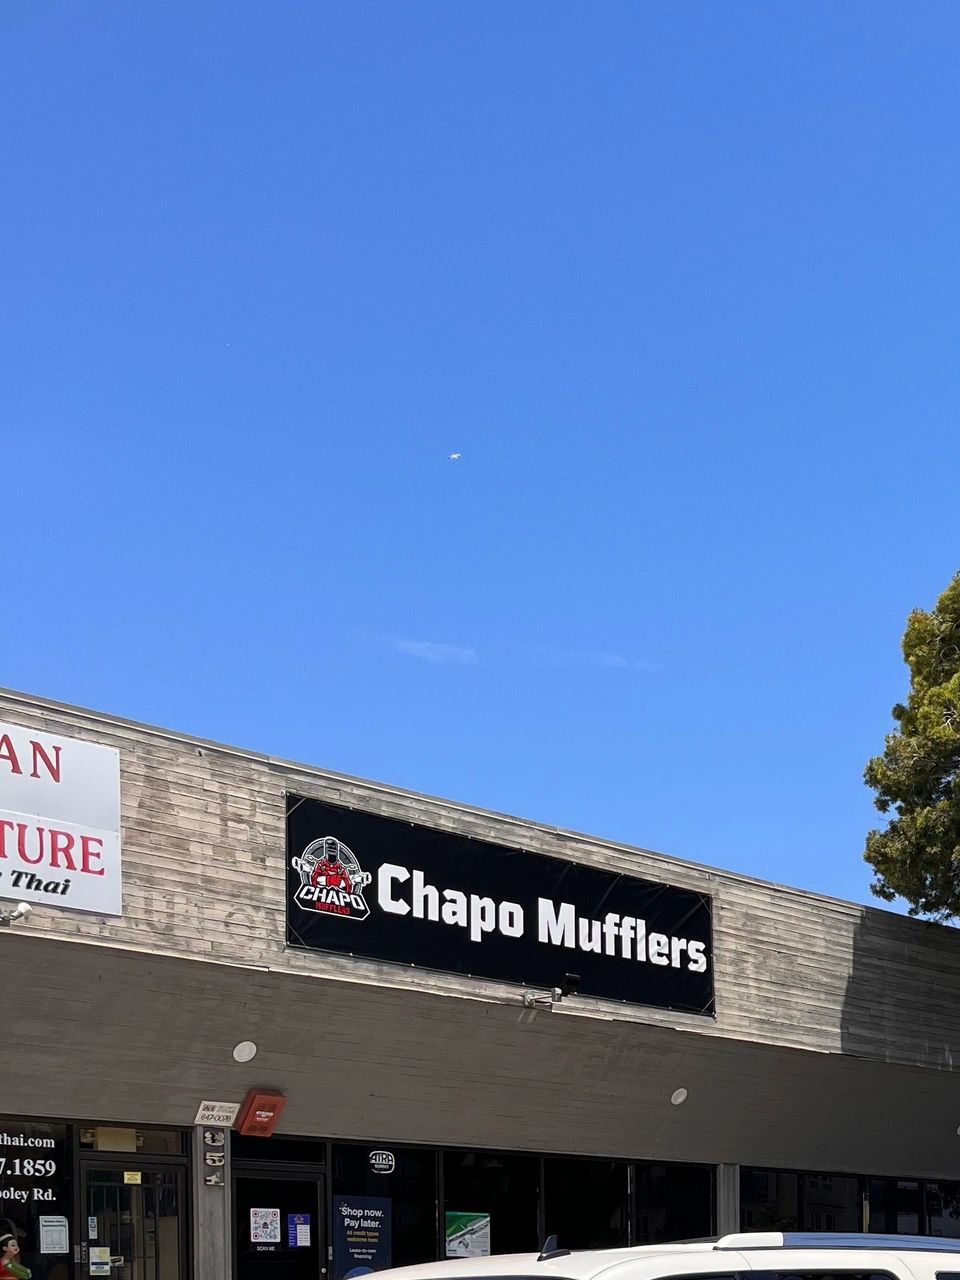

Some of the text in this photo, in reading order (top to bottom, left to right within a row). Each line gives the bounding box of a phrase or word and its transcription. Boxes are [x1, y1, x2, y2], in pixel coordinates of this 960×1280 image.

[10, 870, 71, 896] Thai
[300, 885, 366, 911] CHAPO
[315, 901, 351, 915] MUFFLERS
[377, 863, 707, 972] Chapo Mufflers
[0, 1187, 57, 1203] oley Rd.
[341, 1206, 385, 1218] Shop now.
[344, 1218, 381, 1228] Pay later.
